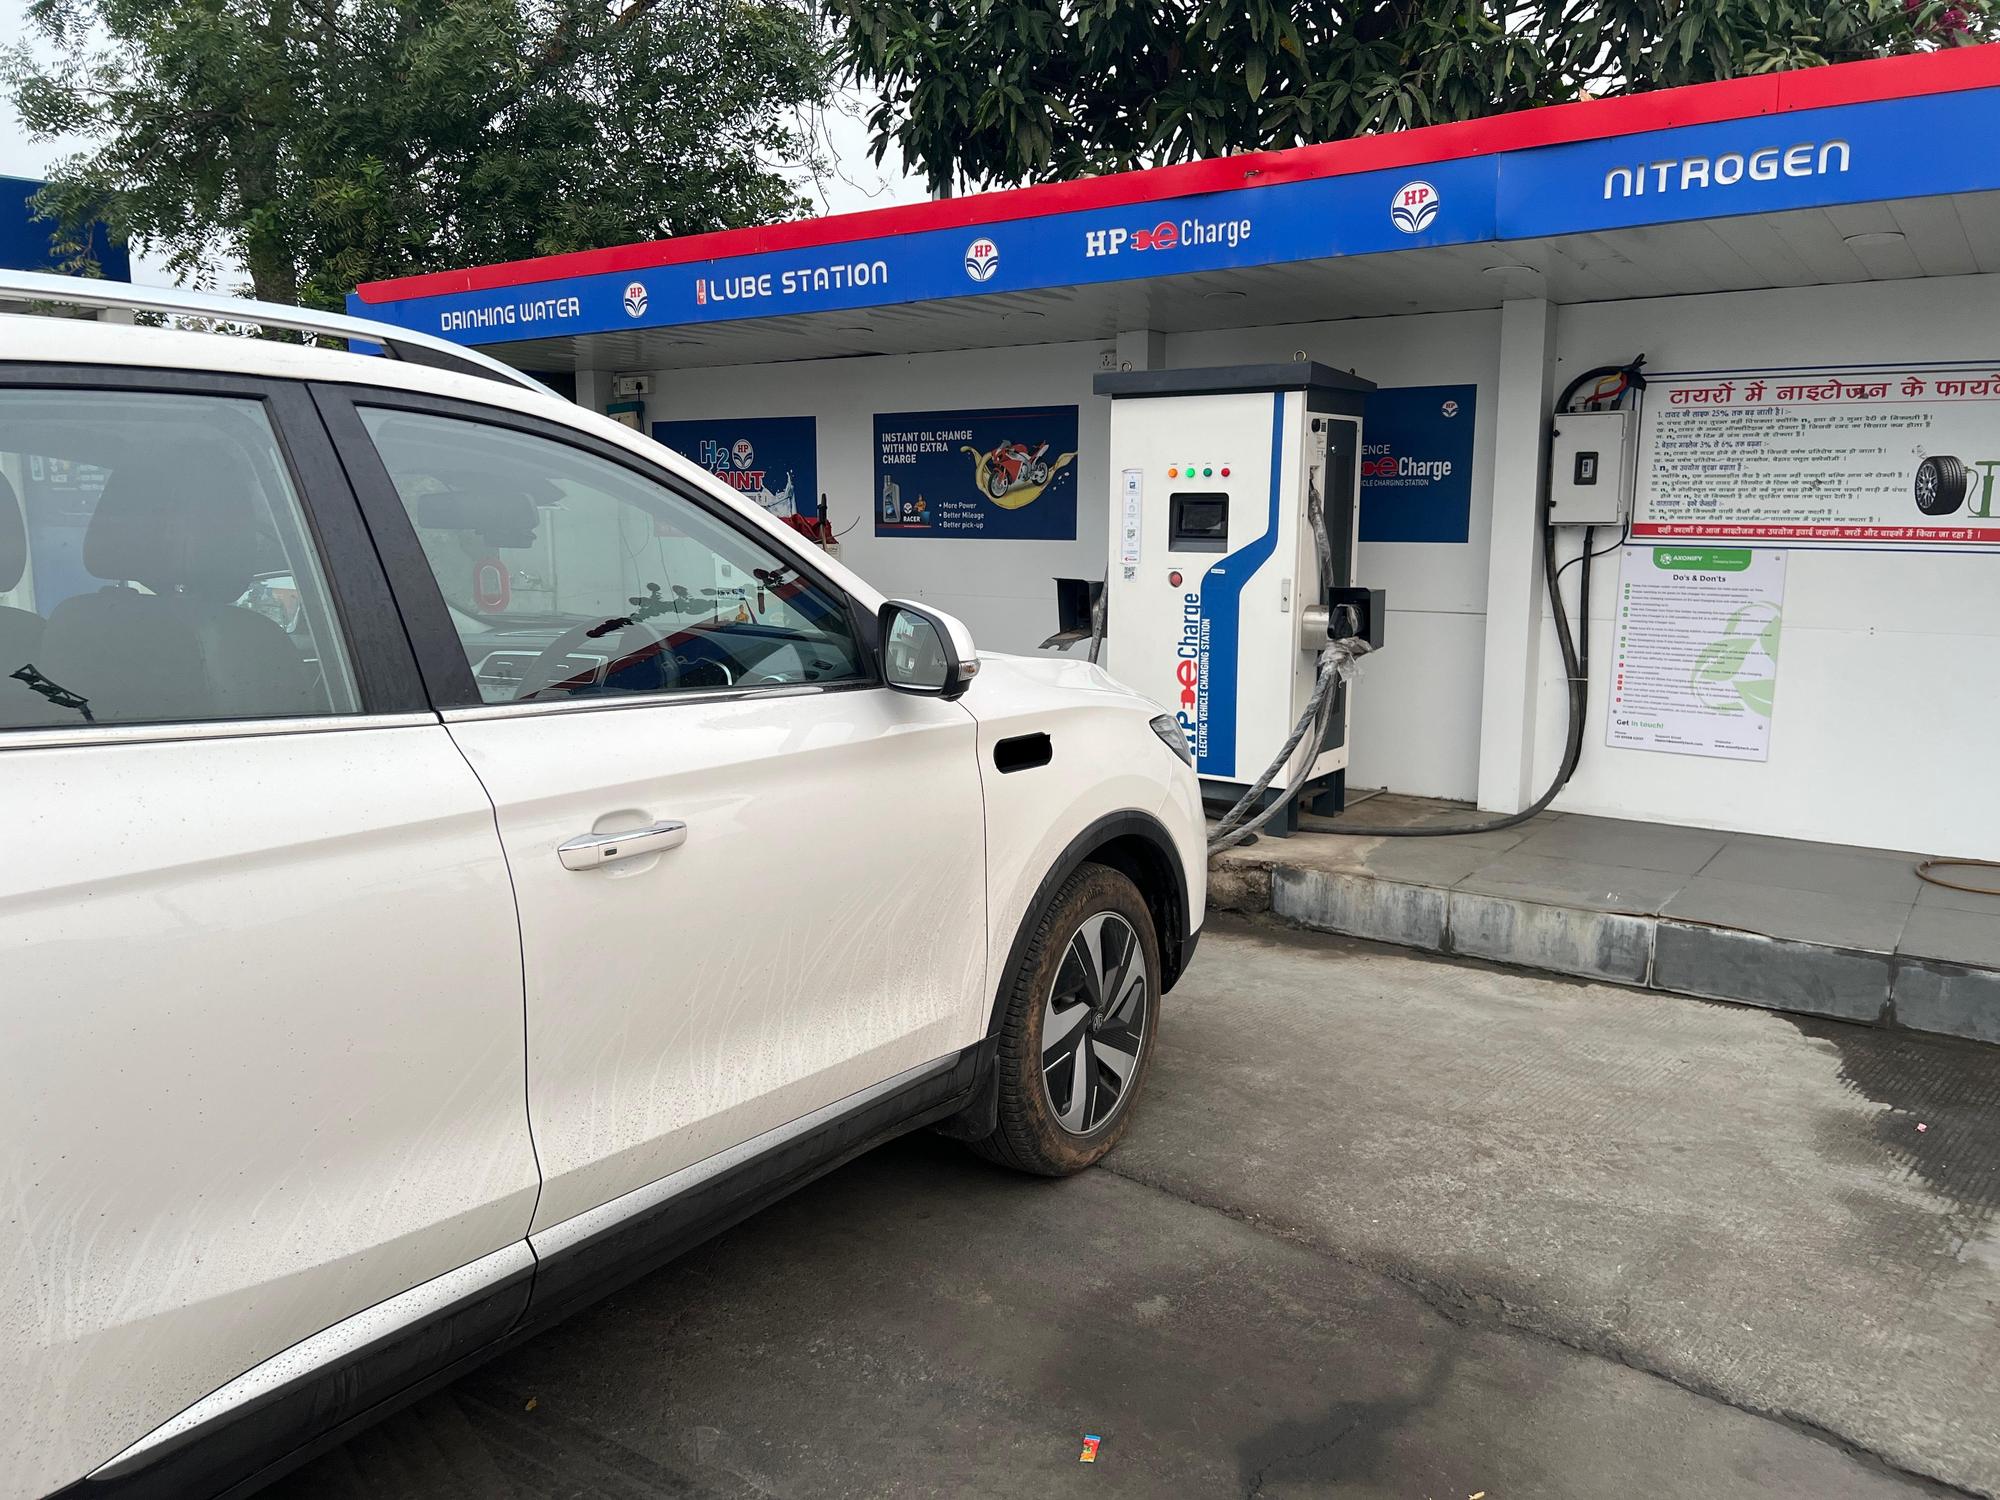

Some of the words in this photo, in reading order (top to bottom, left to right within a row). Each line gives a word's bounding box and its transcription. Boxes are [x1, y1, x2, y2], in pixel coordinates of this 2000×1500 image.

[1603, 140, 1850, 200] NITROGEN
[1403, 188, 1430, 206] HP
[974, 244, 992, 258] HP
[1086, 228, 1127, 257] HP
[710, 274, 772, 301] LUBE
[781, 261, 888, 294] STATION
[630, 287, 643, 299] HP
[440, 304, 516, 331] DRINKING
[520, 297, 580, 322] WATER
[1669, 382, 1736, 404] टायरों
[1744, 380, 1767, 402] में
[1901, 376, 1926, 397] के
[1711, 409, 1729, 417] 25%
[882, 432, 919, 442] INSTANT
[921, 431, 934, 441] OIL
[936, 430, 973, 441] CHANGE
[737, 444, 749, 453] HP
[882, 443, 904, 453] WITH
[906, 443, 918, 453] NO
[920, 442, 949, 452] EXTRA
[1361, 444, 1391, 455] ENCE
[882, 454, 917, 464] CHARGE
[714, 471, 765, 491] OINT
[962, 512, 984, 520] Mileage
[961, 521, 984, 530] pick-up
[1200, 618, 1211, 650] STATION
[1200, 651, 1210, 690] CHARGING
[1199, 691, 1209, 721] VEHICLE
[1199, 722, 1208, 757] ELECTRIC
